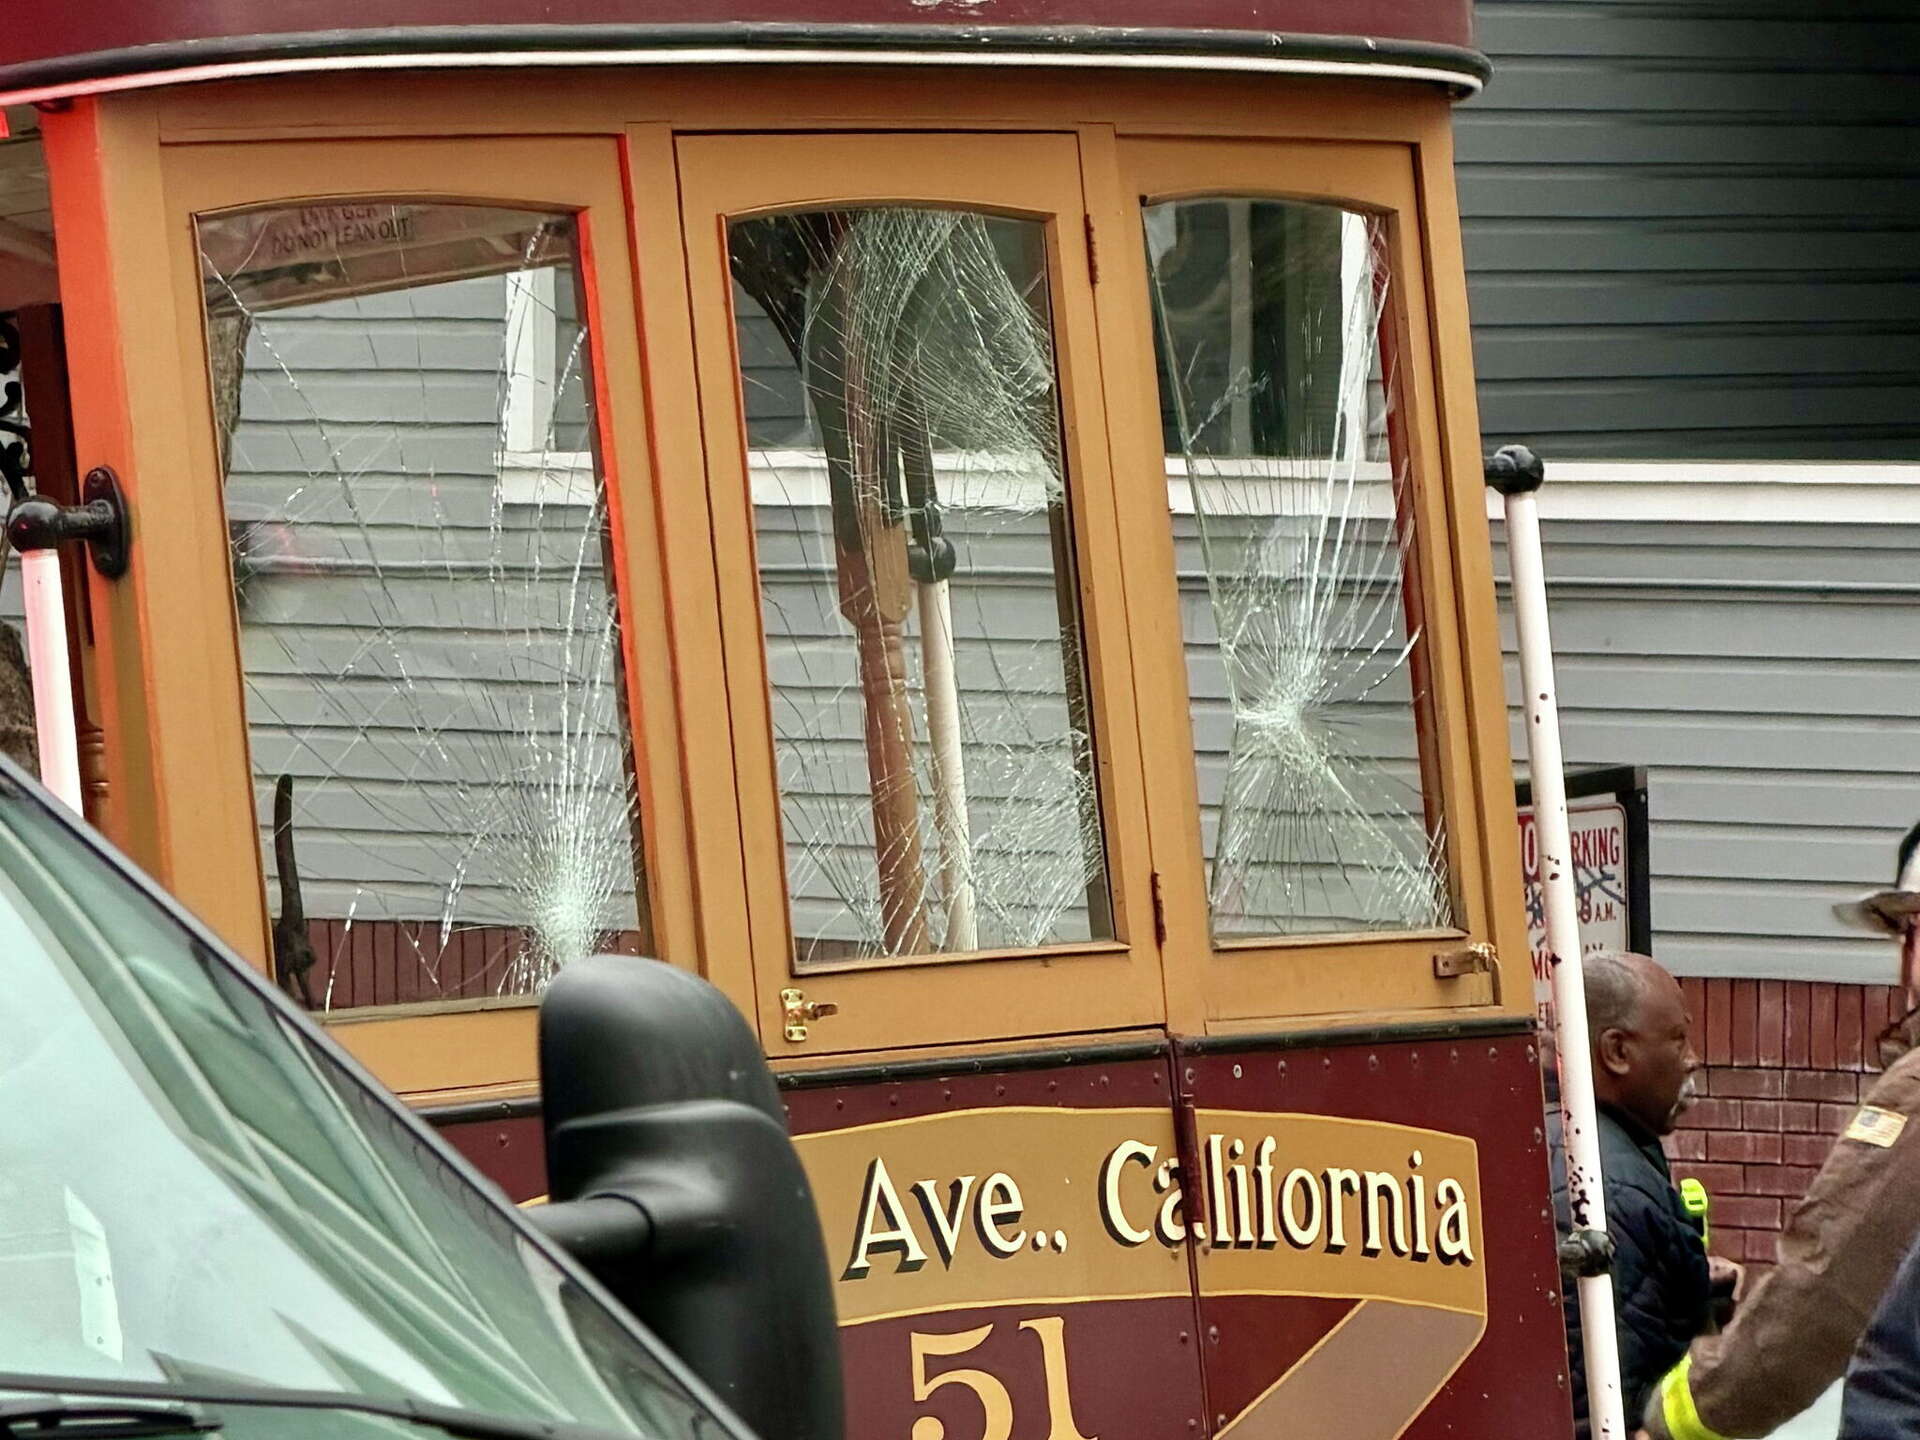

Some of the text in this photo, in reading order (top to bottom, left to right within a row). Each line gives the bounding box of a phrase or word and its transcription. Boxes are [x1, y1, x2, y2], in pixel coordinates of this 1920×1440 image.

[272, 217, 409, 254] DO NOT LEAN OUT
[1571, 826, 1620, 869] RKING
[1595, 901, 1617, 922] A.M.
[840, 1134, 1474, 1282] Ave., California
[911, 1315, 1098, 1440] 51
